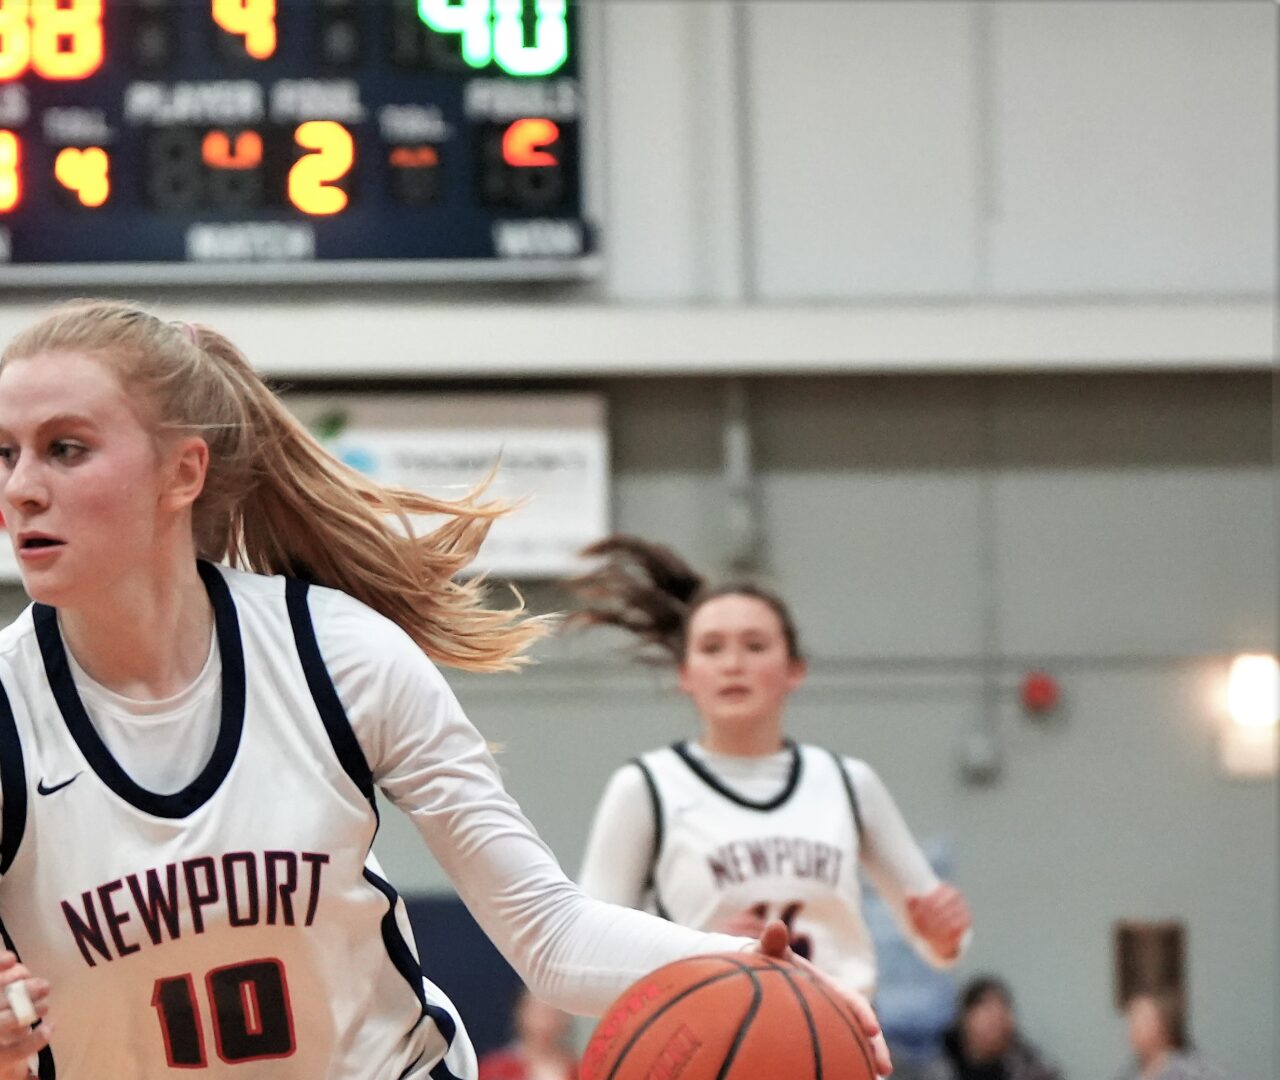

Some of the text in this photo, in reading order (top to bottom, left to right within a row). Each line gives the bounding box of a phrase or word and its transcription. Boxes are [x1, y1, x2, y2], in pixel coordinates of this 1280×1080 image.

[212, 0, 277, 61] 4
[418, 0, 568, 77] 40
[125, 79, 264, 125] PLAYER
[287, 120, 355, 216] 2
[705, 835, 844, 888] NEWPORT
[60, 850, 330, 968] NEWPORT
[150, 957, 297, 1069] 10
